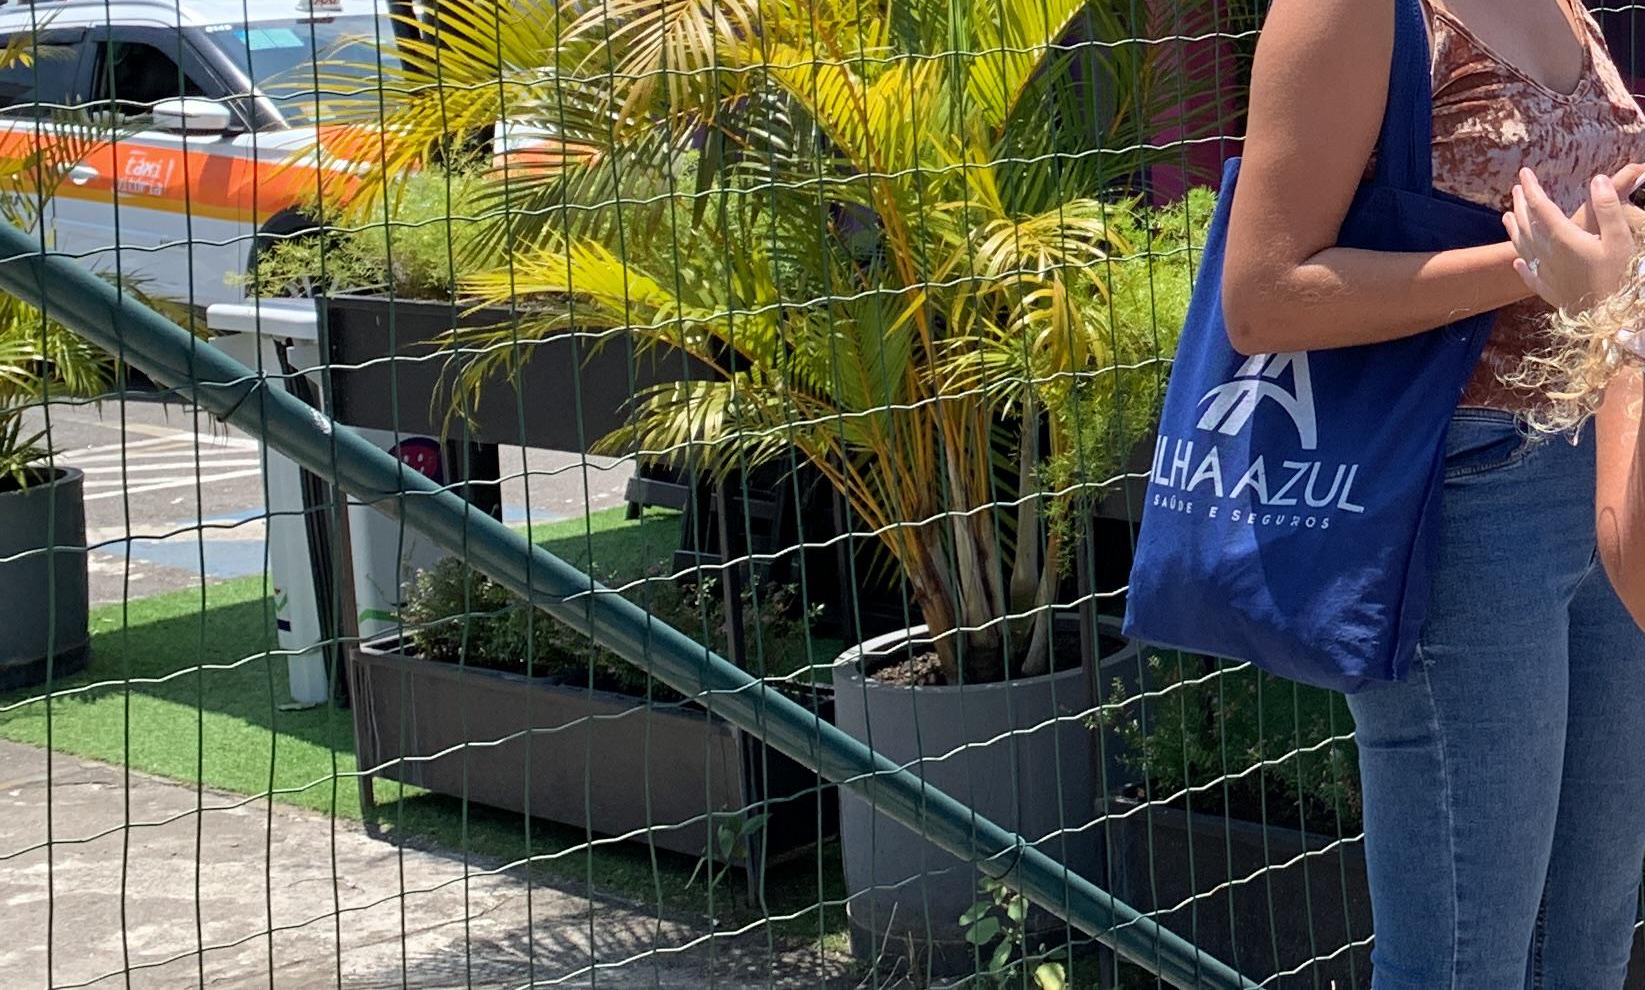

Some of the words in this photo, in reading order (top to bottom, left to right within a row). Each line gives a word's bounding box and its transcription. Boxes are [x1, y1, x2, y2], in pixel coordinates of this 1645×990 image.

[1150, 435, 1223, 497] ILHA
[1229, 454, 1365, 513] AZUL
[1153, 494, 1193, 514] SAÚDE
[1208, 506, 1220, 518] E
[1231, 509, 1330, 529] SEGUROS
